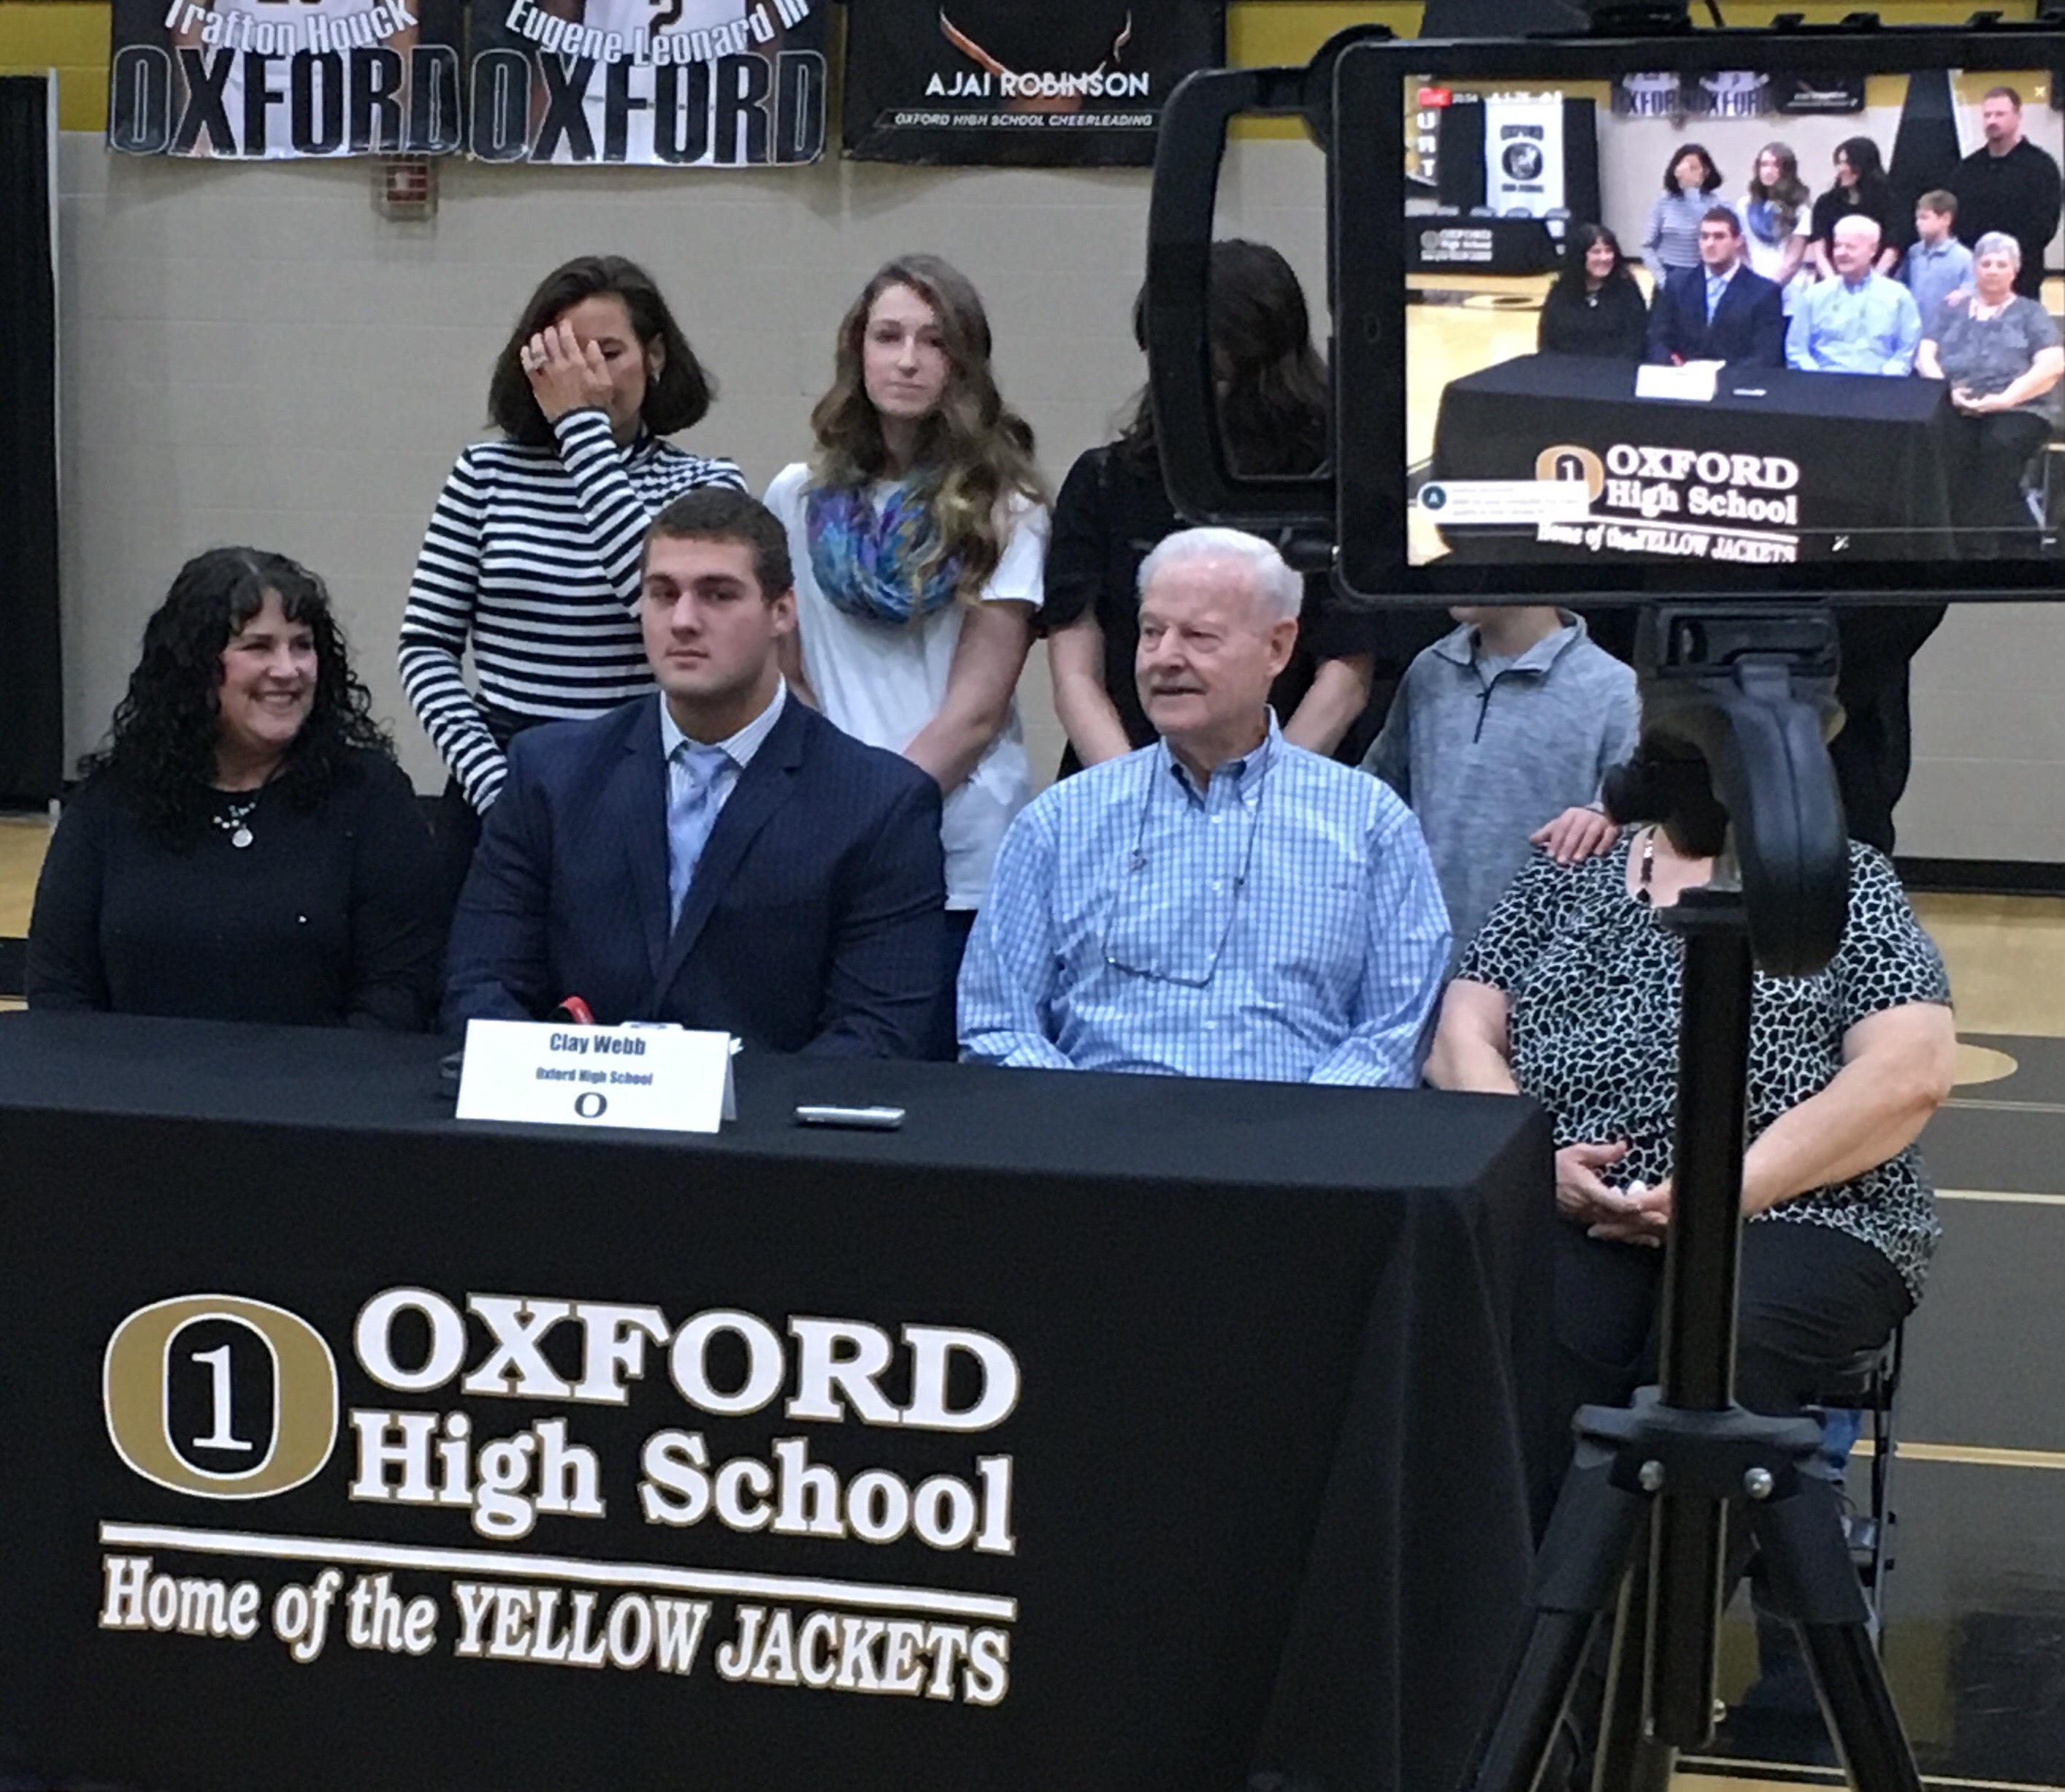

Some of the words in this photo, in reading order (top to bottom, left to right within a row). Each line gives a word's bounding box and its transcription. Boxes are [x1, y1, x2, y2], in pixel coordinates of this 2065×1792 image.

[307, 0, 419, 54] Houck
[505, 0, 623, 64] Eugene
[634, 4, 775, 66] Leonard
[110, 45, 461, 156] OXFORD
[470, 49, 826, 164] OXFORD
[925, 72, 990, 96] AJAI
[1000, 72, 1150, 96] ROBINSON
[894, 113, 949, 126] OXFORD
[952, 114, 989, 126] HIGH
[991, 114, 1044, 126] SCHOOL
[1049, 114, 1153, 126] CHEERLEADING
[1606, 444, 1798, 489] OXFORD
[1606, 479, 1679, 517] High
[1687, 486, 1797, 524] School
[1585, 524, 1605, 551] of
[1637, 530, 1709, 556] YELLOW
[550, 1033, 589, 1054] Clay
[594, 1035, 646, 1055] Webb
[536, 1066, 576, 1081] Oxford
[579, 1070, 607, 1084] High
[610, 1071, 654, 1086] School
[353, 1286, 1022, 1432] OXFORD
[191, 1344, 253, 1452] 1
[348, 1408, 606, 1541] High
[637, 1428, 1016, 1555] School
[99, 1553, 261, 1640] Home
[272, 1567, 344, 1663] of
[345, 1572, 437, 1655] the
[452, 1580, 712, 1675] YELLOW
[714, 1605, 1011, 1707] JACKETS
